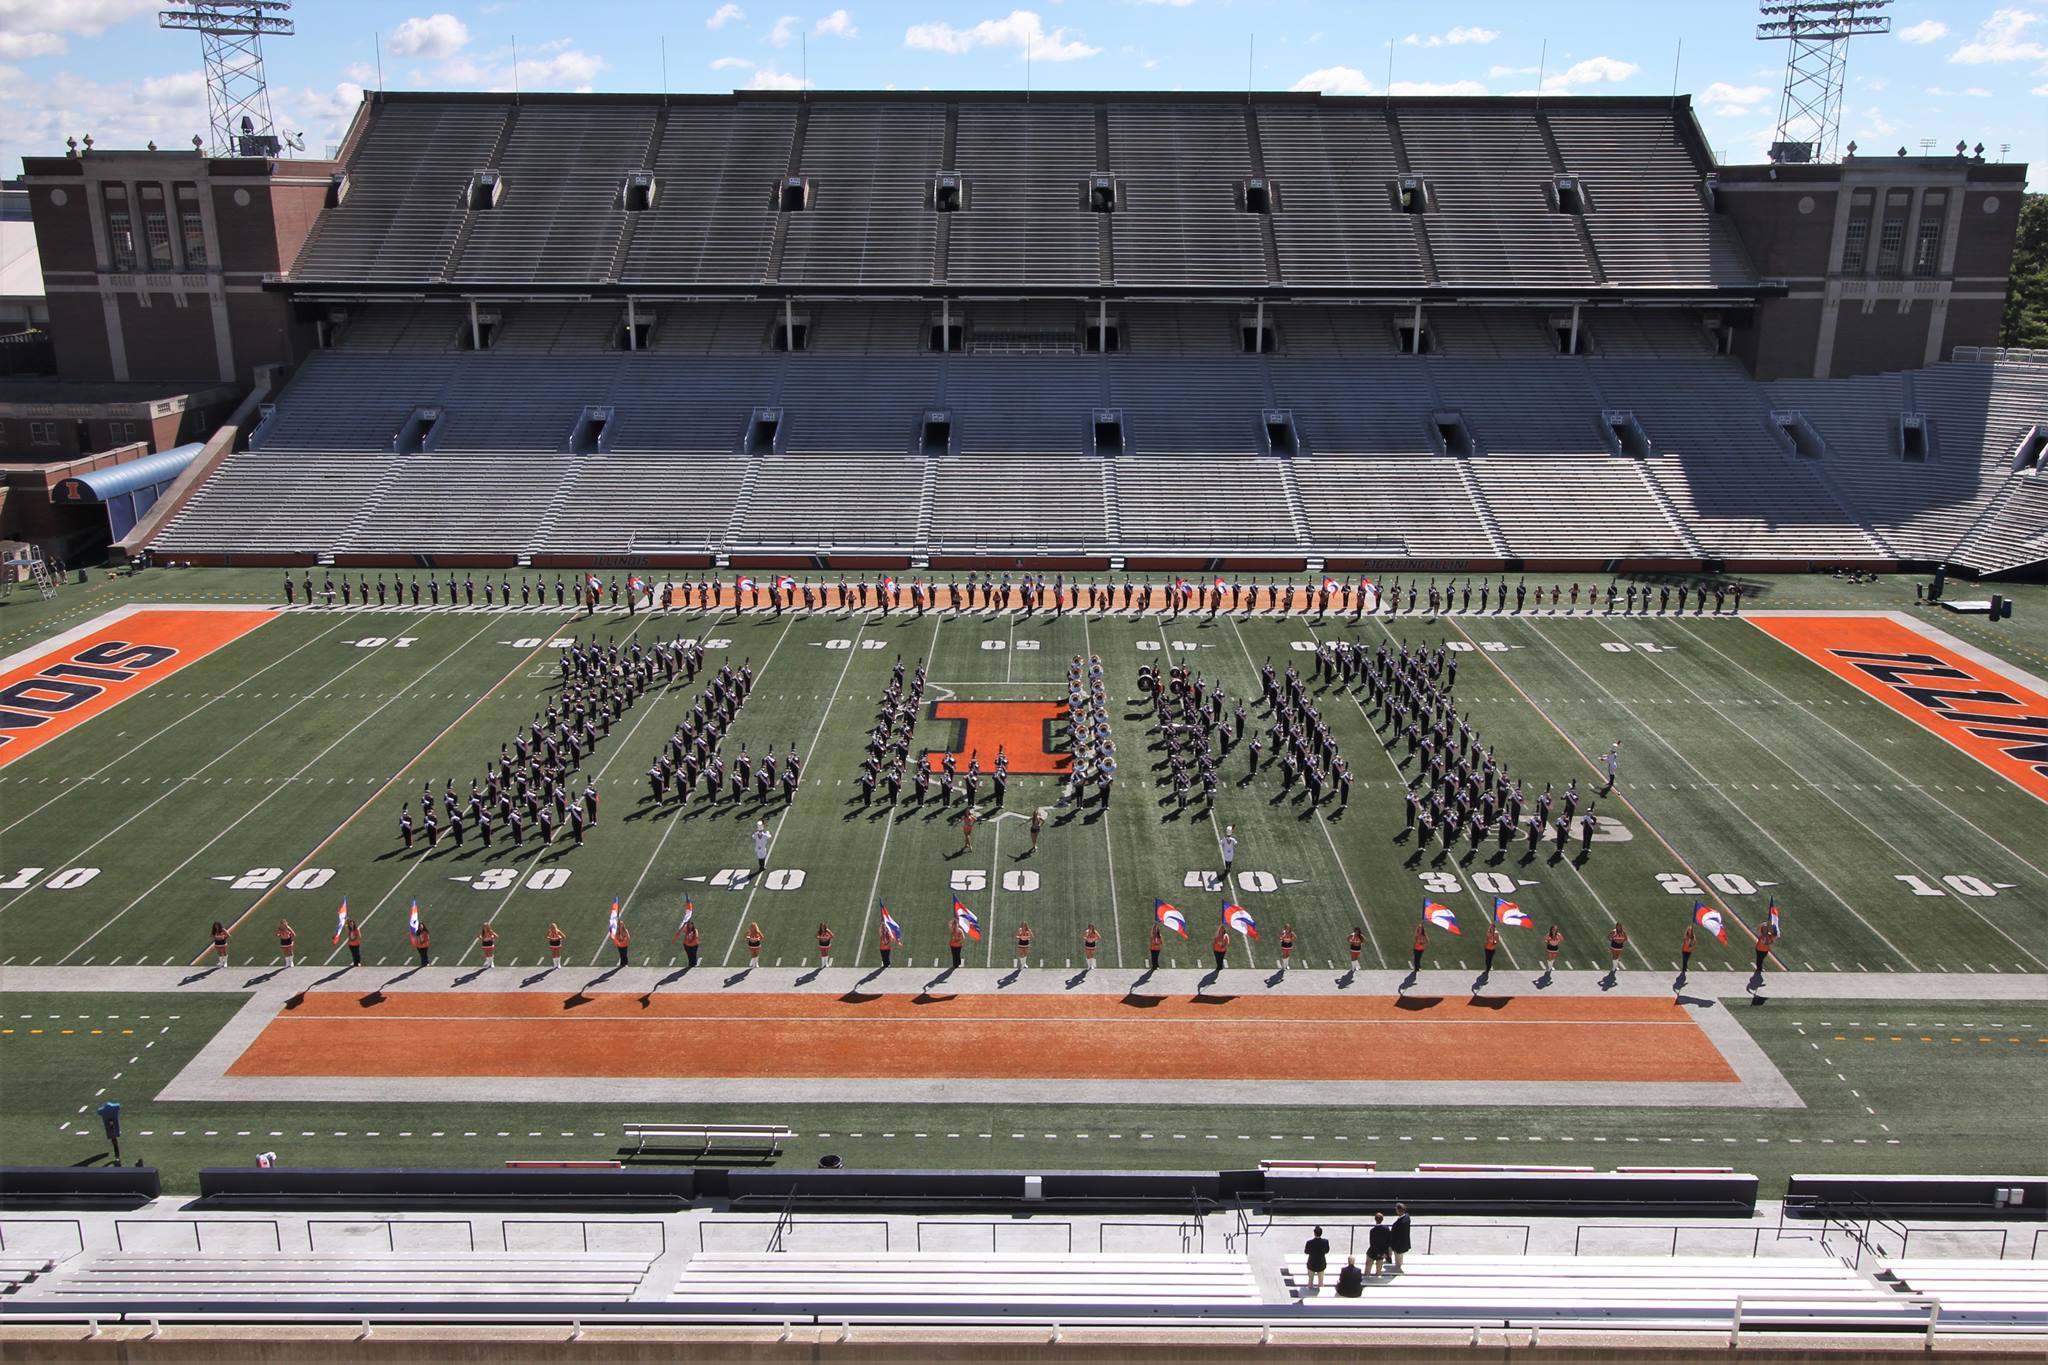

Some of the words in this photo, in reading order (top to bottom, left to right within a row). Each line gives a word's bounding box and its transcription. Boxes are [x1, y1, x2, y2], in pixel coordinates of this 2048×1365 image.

[592, 555, 649, 567] ILLINOIS
[1363, 559, 1426, 570] FIGHTING
[1428, 559, 1471, 570] ILLINI
[950, 869, 1041, 892] 50
